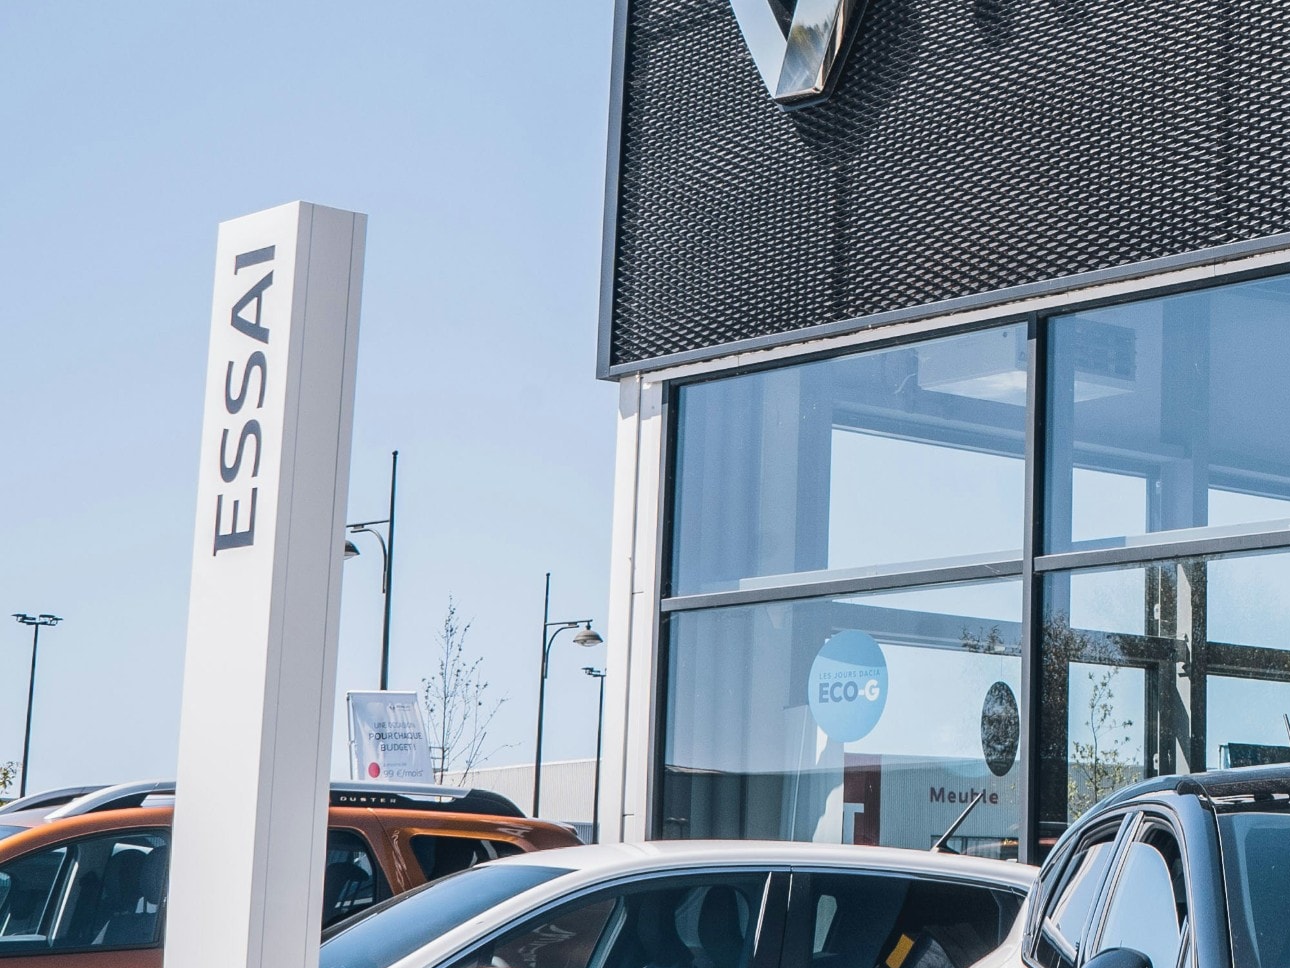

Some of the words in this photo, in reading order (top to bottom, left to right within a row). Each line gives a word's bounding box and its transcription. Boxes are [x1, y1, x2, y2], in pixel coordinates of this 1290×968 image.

[213, 244, 276, 557] ESSAI
[819, 671, 832, 680] LES
[833, 670, 857, 680] JOURS
[859, 668, 881, 678] DACIA
[818, 679, 881, 703] ECO-G
[368, 732, 395, 741] POUR
[395, 732, 424, 740] CHAQUE
[383, 769, 395, 778] 99
[340, 795, 397, 803] DUSTER
